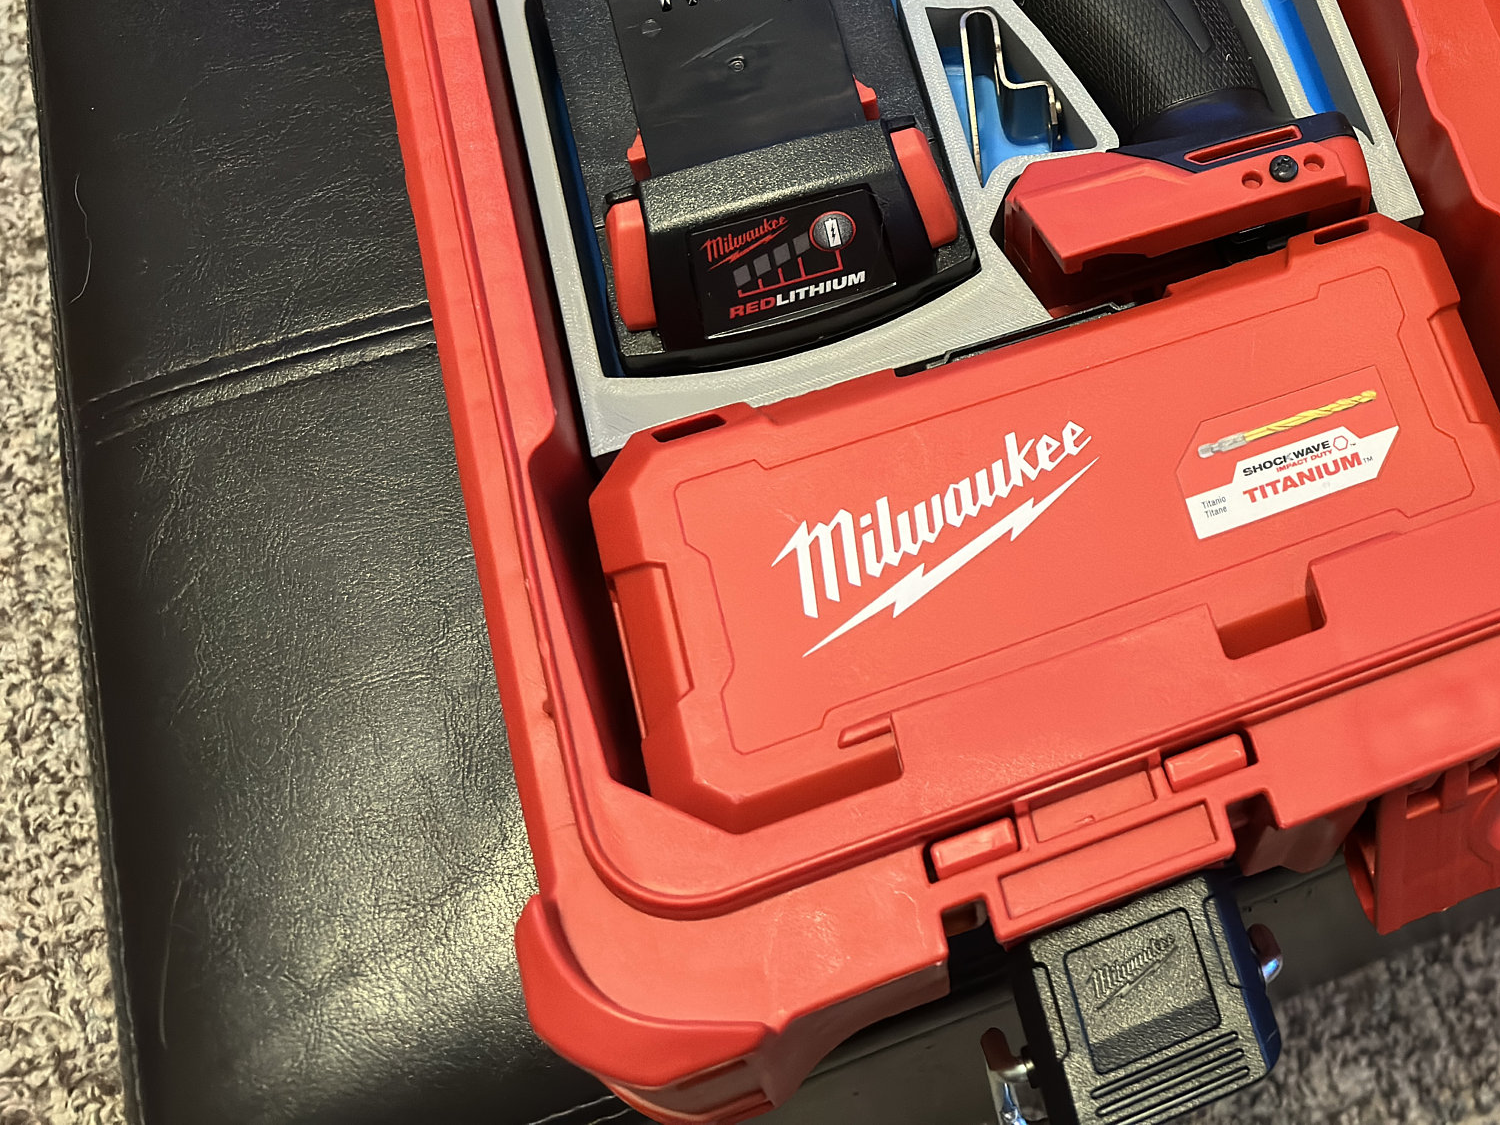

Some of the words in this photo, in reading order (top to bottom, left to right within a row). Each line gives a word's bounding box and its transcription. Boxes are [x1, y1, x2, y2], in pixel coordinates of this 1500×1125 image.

[700, 216, 788, 262] Milwaukee
[729, 271, 866, 319] REDLITHIUM
[1243, 440, 1331, 477] SHOCKWAVE
[1276, 459, 1308, 472] IMPACT
[1310, 449, 1333, 461] DUTY
[771, 420, 1092, 618] Milwaukee
[1201, 496, 1227, 510] Titanio
[1204, 506, 1227, 519] Titane
